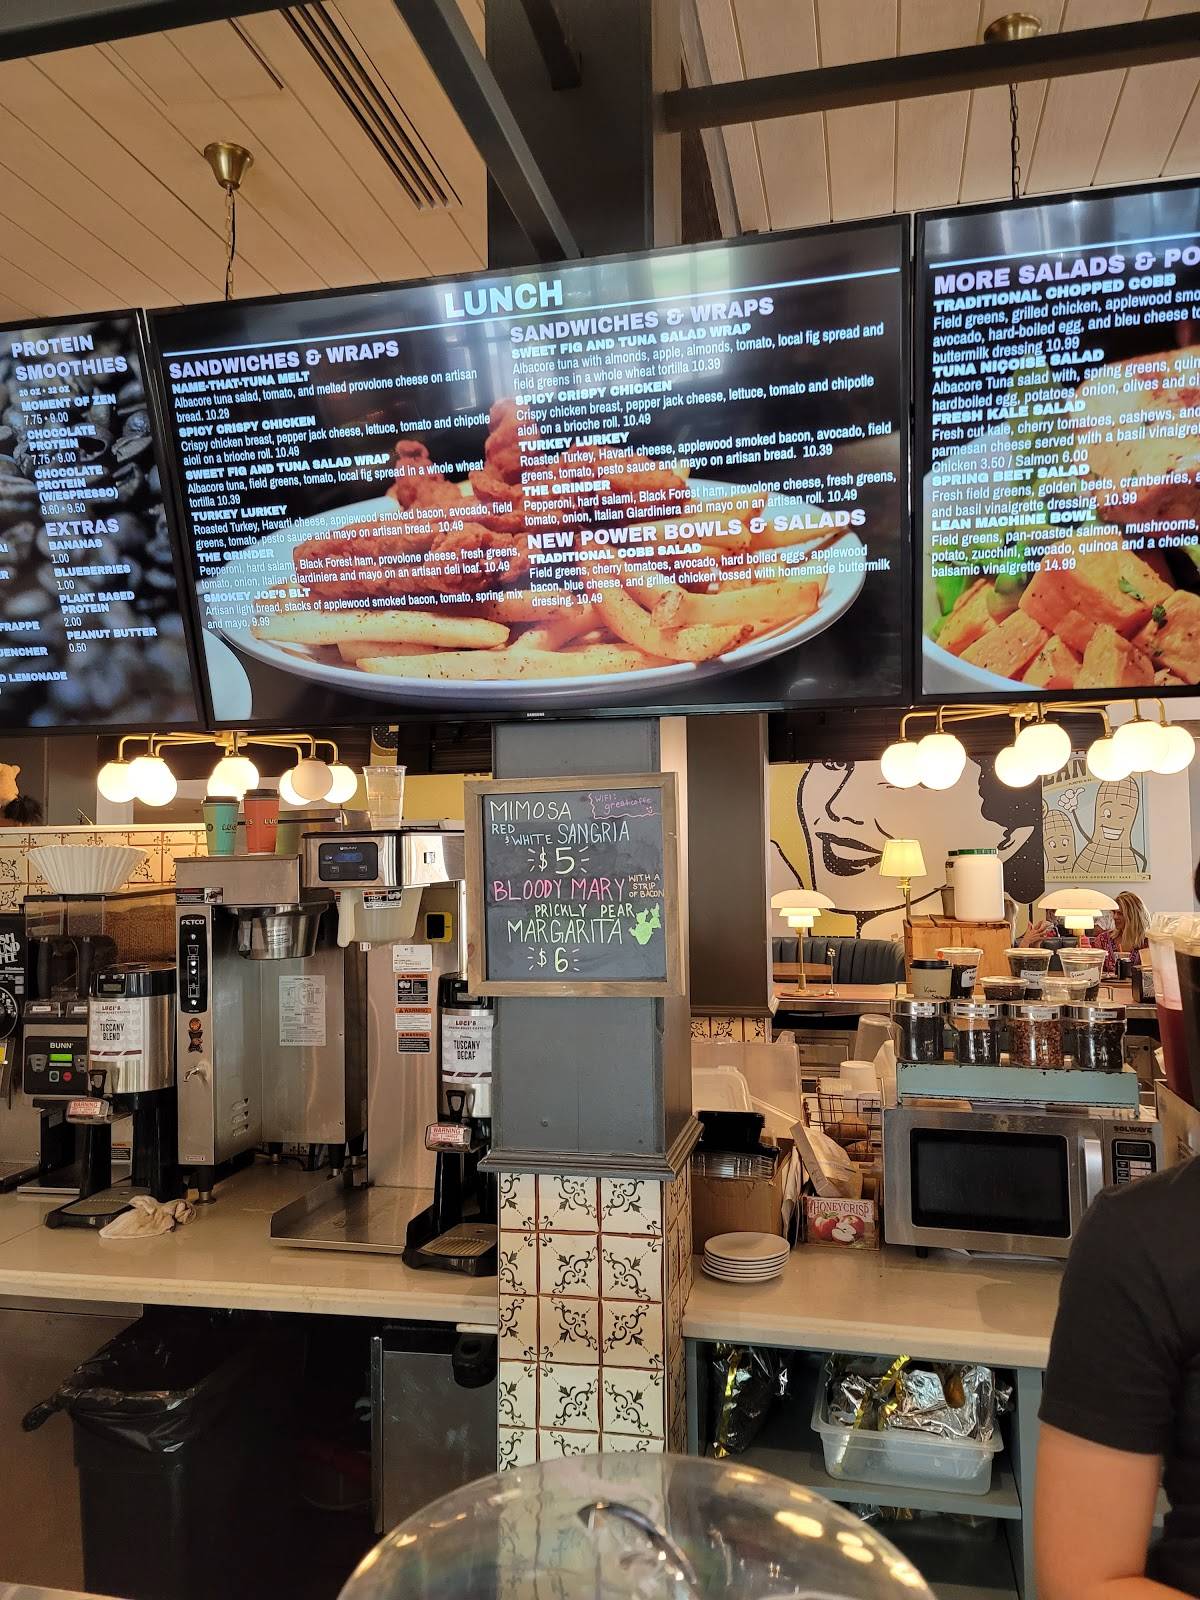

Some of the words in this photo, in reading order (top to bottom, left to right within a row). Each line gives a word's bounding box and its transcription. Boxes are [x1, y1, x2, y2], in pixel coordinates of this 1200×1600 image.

[934, 269, 1010, 294] MORE
[1018, 256, 1124, 285] SALADS
[1134, 252, 1155, 272] &
[445, 280, 563, 318] LUNCH
[933, 289, 1042, 313] TRADITIONAL
[1045, 279, 1124, 300] CHOPPED
[1128, 274, 1176, 290] COBB
[510, 311, 658, 343] SANDWICHES
[667, 309, 681, 327] &
[691, 297, 774, 323] WRAPS
[11, 335, 94, 358] PROTEIN
[512, 343, 556, 359] SWEET
[560, 340, 582, 354] FIG
[586, 337, 614, 351] AND
[617, 333, 656, 348] TUNA
[660, 328, 706, 343] SALAD
[710, 323, 751, 338] WRAP
[932, 346, 989, 364] buttermilk
[992, 340, 1042, 361] dressing
[1046, 336, 1079, 352] 10.99
[15, 356, 128, 381] SMOOTHIES
[169, 350, 299, 379] SANDWICHES
[306, 348, 321, 365] &
[326, 341, 398, 363] WRAPS
[932, 363, 976, 378] TUNA
[1050, 349, 1104, 366] SALAD
[172, 374, 275, 394] NAME-THAT-TUNA
[277, 371, 309, 384] MELT
[515, 391, 556, 405] SPICY
[557, 386, 606, 401] CRISPY
[610, 380, 671, 396] CHICKEN
[21, 398, 71, 411] MOMENT
[74, 396, 89, 407] OF
[92, 394, 116, 405] ZEN
[932, 409, 982, 425] FRESH
[986, 404, 1028, 419] KALE
[1032, 399, 1085, 415] SALAD
[26, 425, 96, 440] CHOCOLATE
[178, 424, 213, 438] SPICY
[216, 420, 258, 434] CRISPY
[262, 415, 315, 430] CHICKEN
[28, 438, 79, 451] PROTEIN
[518, 436, 573, 451] TURKEY
[573, 432, 629, 447] LURKEY
[185, 467, 224, 480] SWEET
[227, 465, 247, 477] FIG
[250, 463, 274, 475] AND
[276, 460, 310, 473] TUNA
[312, 456, 352, 470] SALAD
[354, 453, 390, 467] WRAP
[932, 457, 976, 472] Chicken
[980, 455, 1004, 468] 3.50
[1015, 451, 1058, 466] Salmon
[1062, 449, 1088, 463] 6.00
[34, 465, 103, 479] CHOCOLATE
[932, 470, 988, 486] SPRING
[994, 467, 1034, 481] BEET
[1036, 462, 1090, 477] SALAD
[36, 478, 86, 491] PROTEIN
[522, 483, 549, 496] THE
[551, 479, 610, 494] GRINDER
[39, 487, 118, 503] (W/ESPRESSO)
[931, 504, 951, 517] and
[955, 502, 981, 515] basil
[984, 498, 1044, 517] vinaigrette
[1046, 494, 1099, 512] dressing.
[1104, 491, 1137, 506] 10.99
[191, 508, 238, 522] TURKEY
[240, 504, 286, 518] LURKEY
[931, 517, 971, 531] LEAN
[975, 512, 1046, 528] MACHINE
[1050, 509, 1096, 523] BOWL
[45, 518, 120, 537] EXTRAS
[527, 531, 575, 549] NEW
[580, 525, 656, 545] POWER
[664, 518, 741, 539] BOWLS
[750, 517, 766, 533] &
[774, 509, 866, 531] SALADS
[48, 539, 103, 551] BANANAS
[198, 550, 222, 562] THE
[223, 546, 273, 560] GRINDER
[528, 548, 614, 564] TRADITIONAL
[617, 545, 654, 558] COBB
[657, 542, 704, 555] SALAD
[51, 554, 69, 564] 1.00
[932, 562, 980, 577] balsamic
[982, 558, 1043, 577] vinaigrette
[54, 564, 130, 577] BLUEBERRIES
[57, 580, 74, 591] 1.00
[202, 590, 251, 602] SMOKEY
[288, 587, 310, 598] BLT
[59, 593, 95, 603] PLANT
[98, 591, 135, 602] BASED
[532, 591, 574, 609] dressing.
[576, 590, 602, 603] 10.49
[61, 603, 109, 614] PROTEIN
[64, 617, 82, 627] 2.00
[67, 629, 111, 640] PEANUT
[113, 627, 157, 638] BUTTER
[9, 672, 67, 682] LEMONADE
[490, 801, 572, 821] MIMOSA
[491, 823, 515, 835] RED
[511, 834, 553, 846] WHITE
[557, 821, 630, 844] SANGRIA
[493, 879, 562, 901] BLOODY
[571, 878, 625, 901] MARY
[640, 889, 664, 898] BACON
[535, 904, 587, 917] PRICKLY
[600, 903, 635, 917] PEAR
[507, 919, 623, 944] MARGARITA
[453, 1040, 480, 1050] TUSCANY
[457, 1050, 476, 1060] DECAF
[813, 1201, 870, 1217] HONEYCRISP
